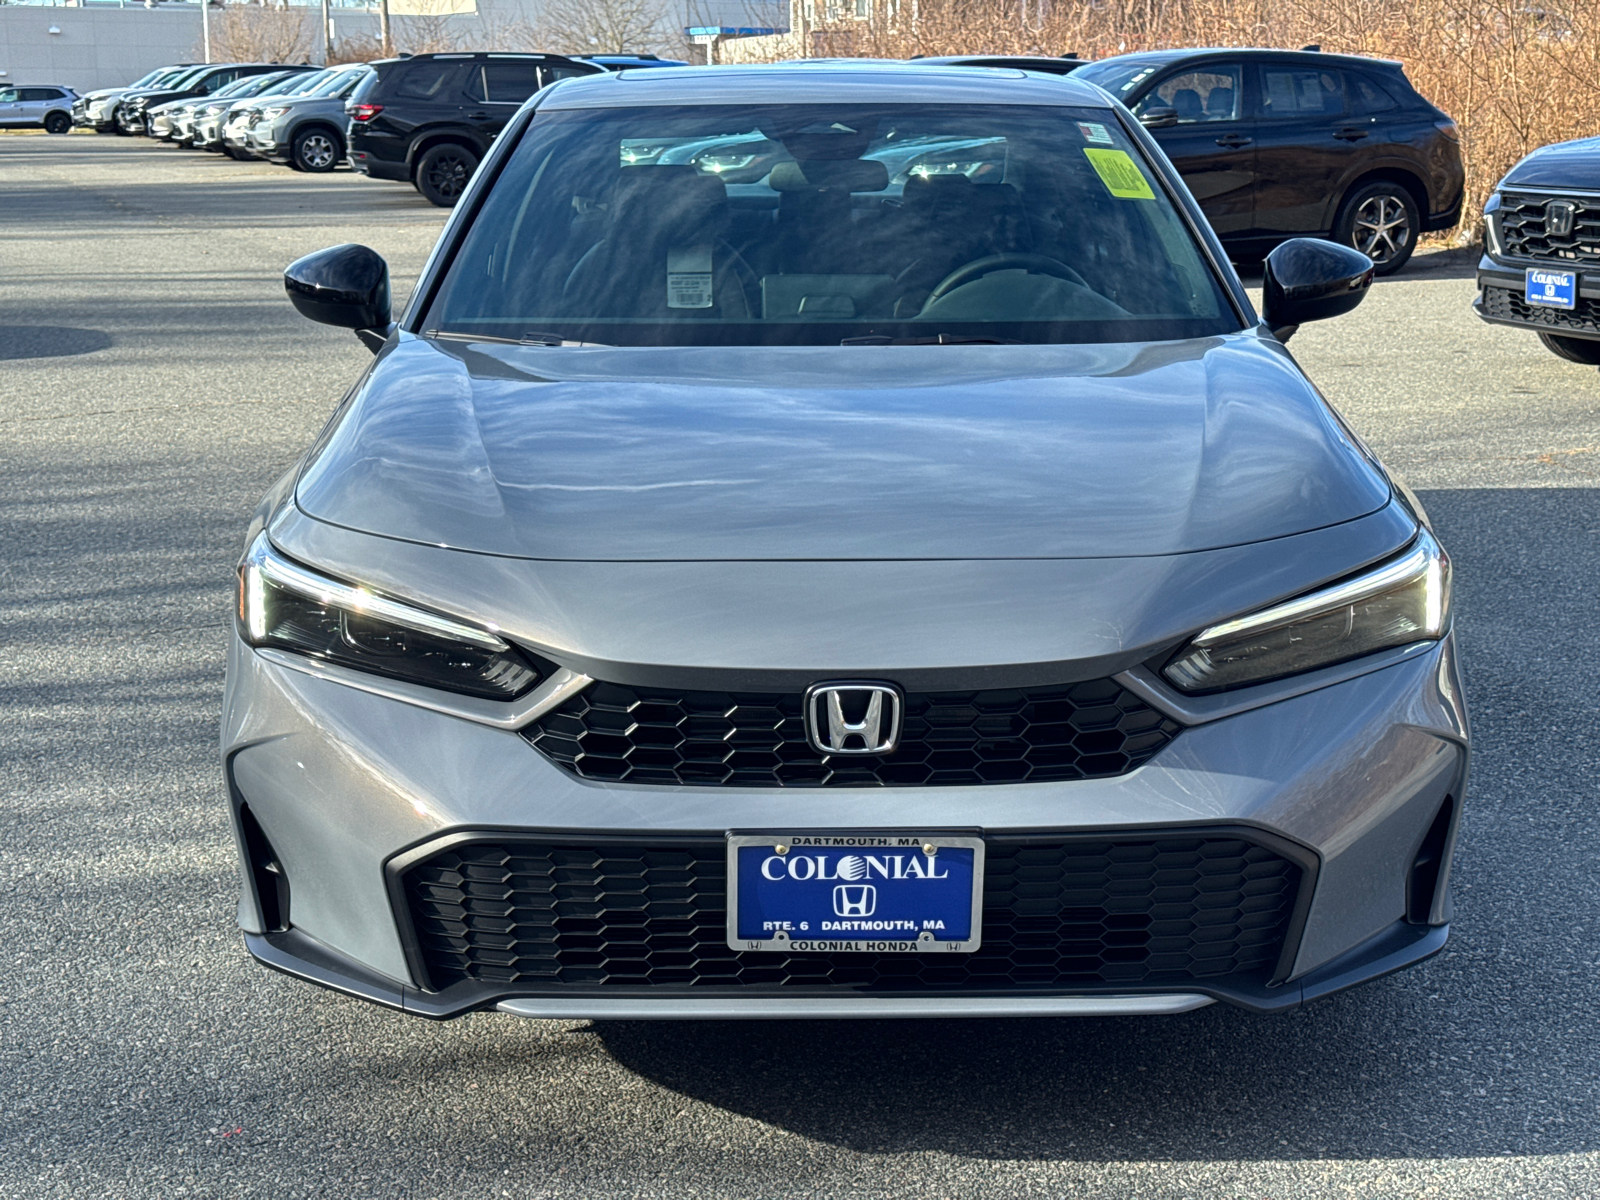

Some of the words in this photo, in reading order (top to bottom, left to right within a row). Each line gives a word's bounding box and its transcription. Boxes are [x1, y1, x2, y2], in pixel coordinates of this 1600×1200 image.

[897, 838, 921, 846] MA
[761, 854, 949, 881] COLONIAL
[763, 921, 796, 931] RTE.
[799, 921, 809, 931] 6
[821, 920, 919, 932] DARTMOUTH,
[922, 920, 946, 930] MA
[789, 941, 862, 951] COLONIAL
[866, 942, 919, 951] HONDA
